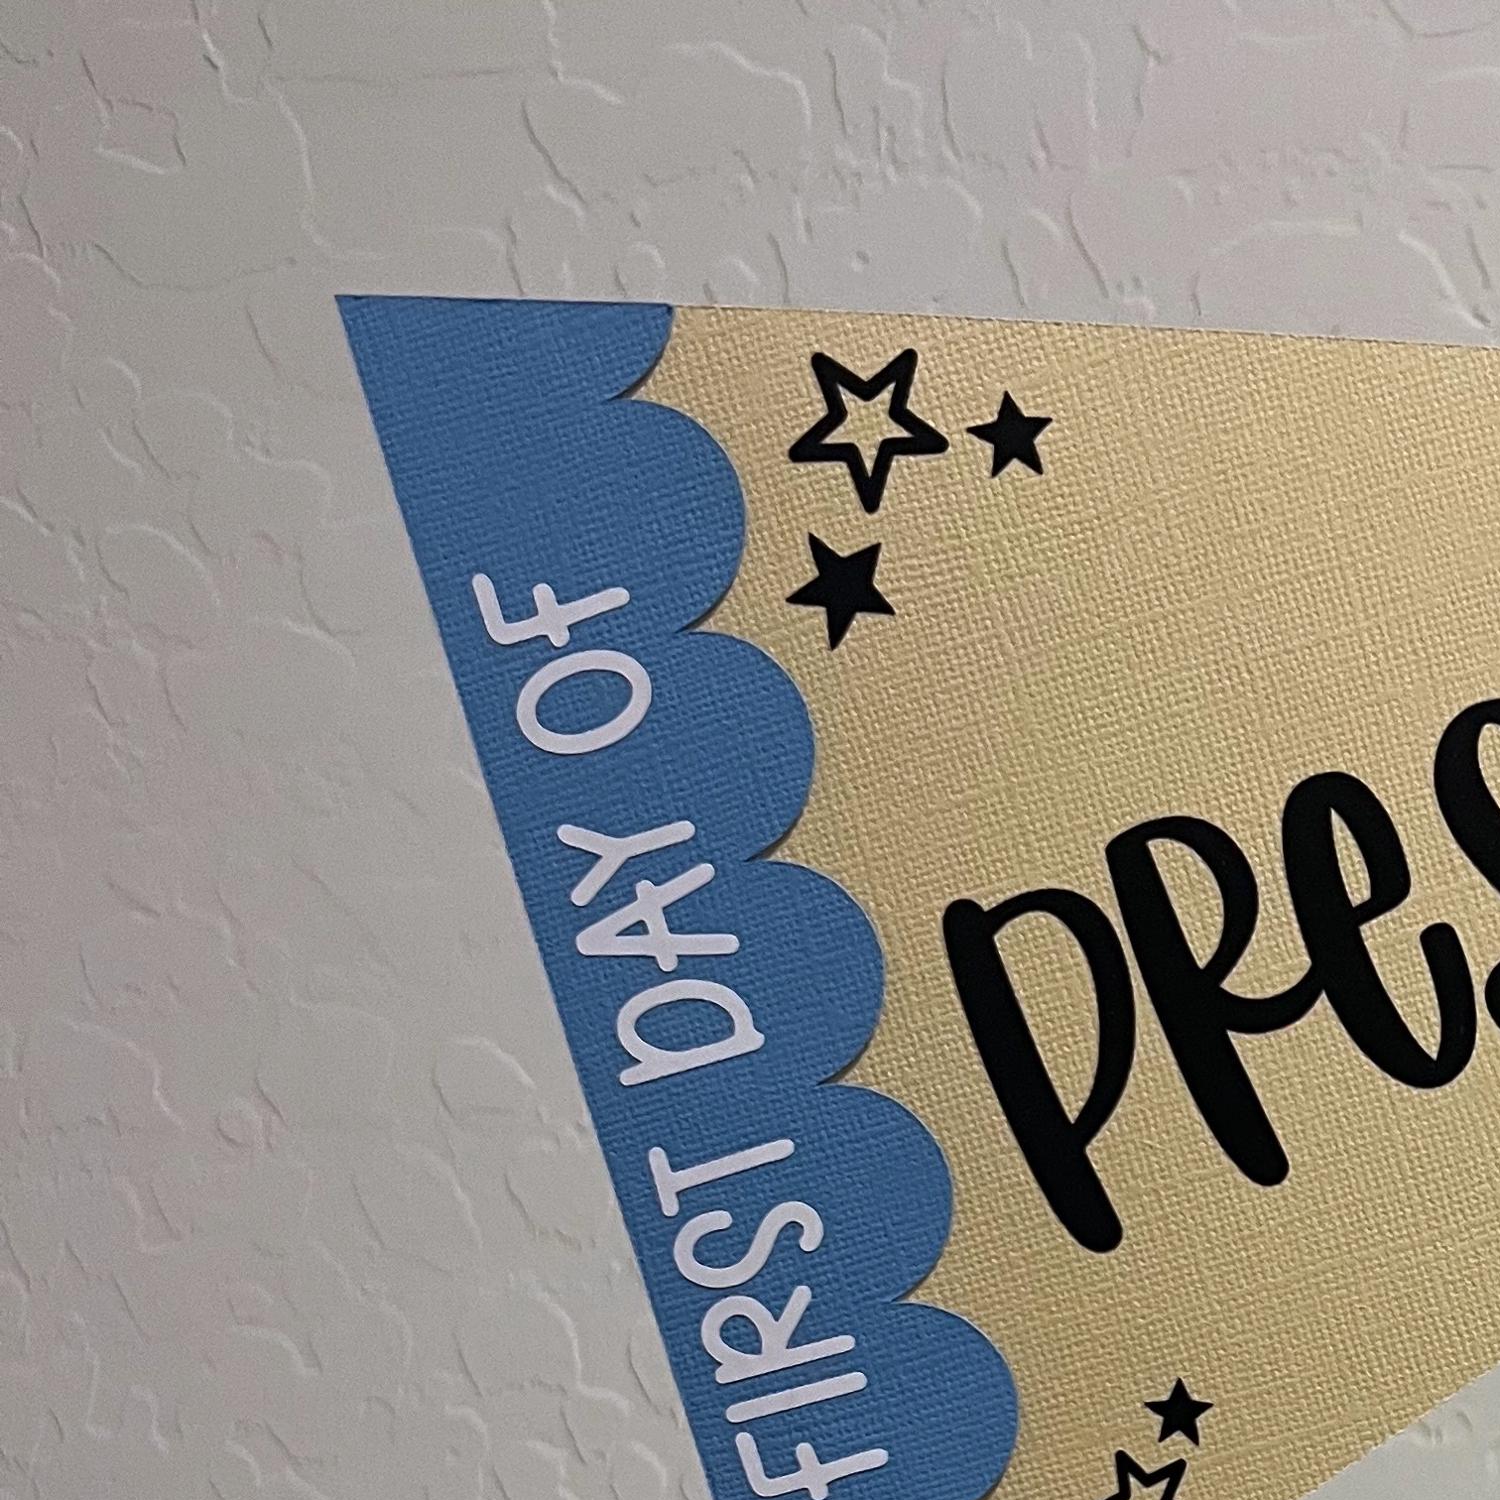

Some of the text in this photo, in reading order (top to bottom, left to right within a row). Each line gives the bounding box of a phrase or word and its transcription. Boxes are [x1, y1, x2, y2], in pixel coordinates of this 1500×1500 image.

[472, 574, 889, 1500] FIRST DAY OF
